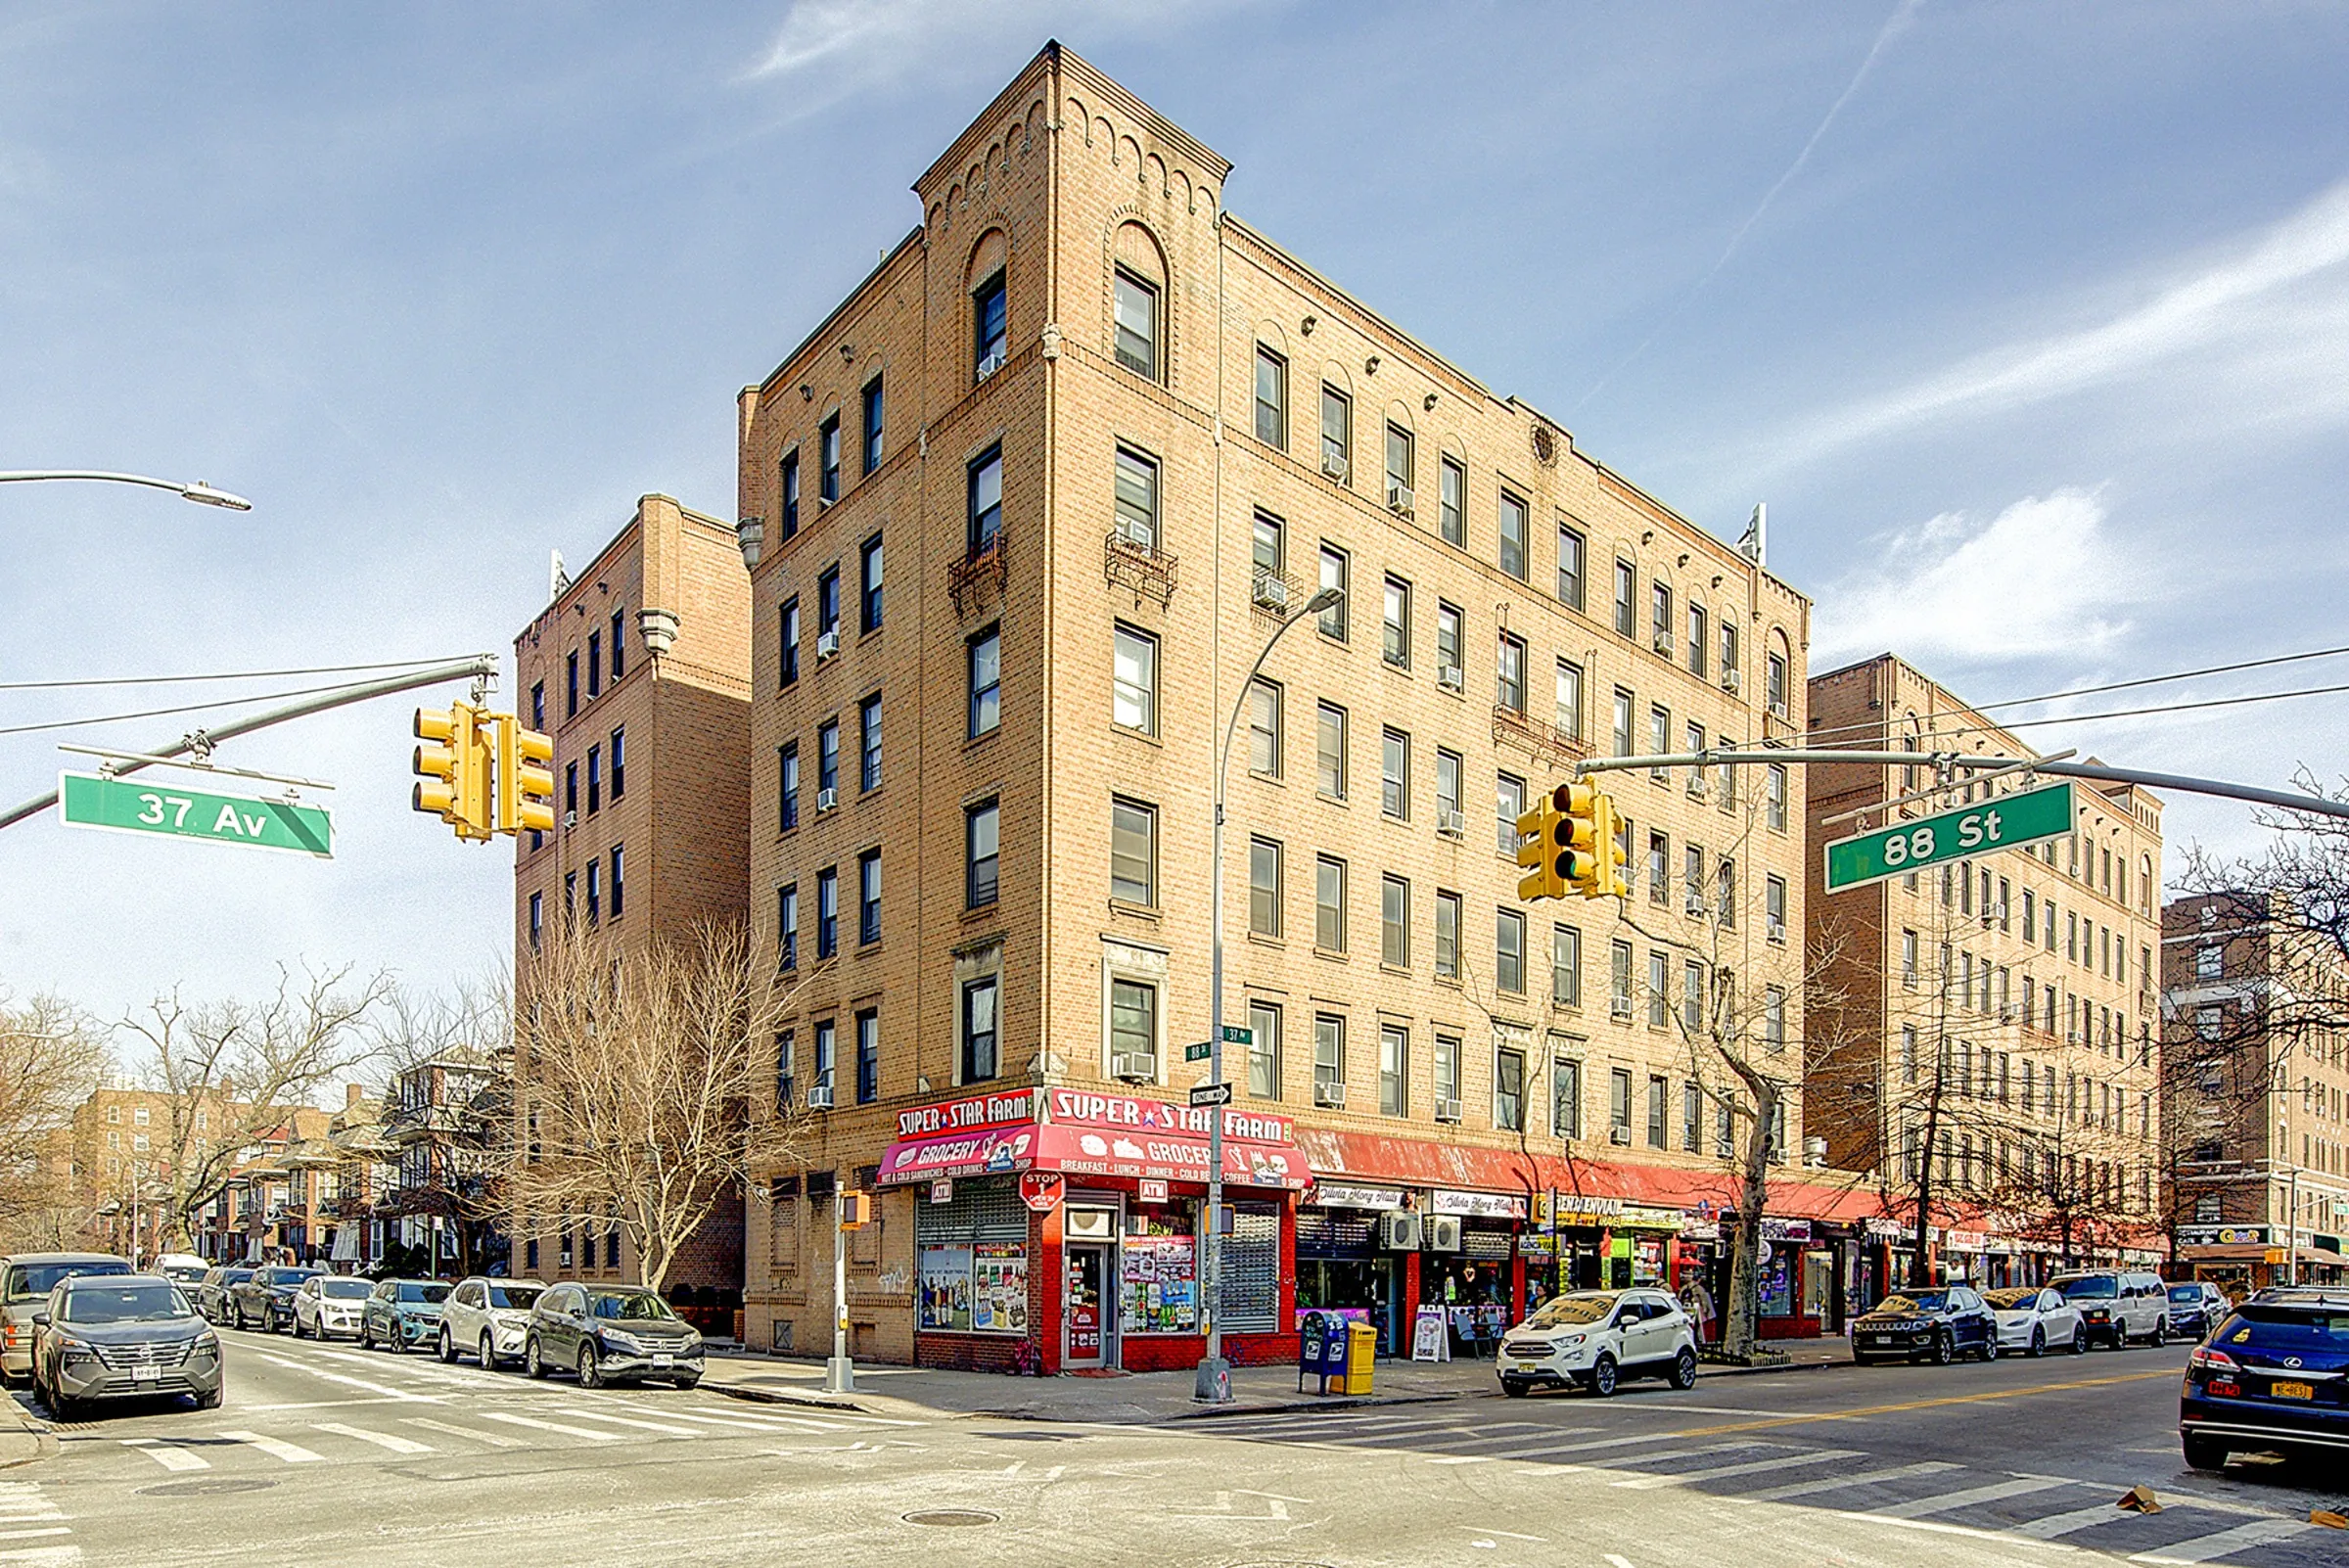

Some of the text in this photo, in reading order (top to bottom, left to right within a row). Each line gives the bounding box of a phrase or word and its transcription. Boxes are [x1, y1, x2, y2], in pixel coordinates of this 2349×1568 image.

[137, 793, 266, 838] 37 Av
[1883, 809, 2002, 866] 88 St
[1228, 1028, 1238, 1041] 37
[1191, 1045, 1200, 1059] 88
[1195, 1089, 1226, 1102] ONE WAY
[898, 1108, 940, 1135] SUPER
[950, 1100, 984, 1128] STAR
[1056, 1092, 1140, 1125] SUPER
[917, 1139, 980, 1165] GROCERY
[1147, 1141, 1212, 1166] GROCER
[882, 1174, 892, 1183] HOT
[897, 1171, 910, 1181] COLD
[910, 1168, 944, 1180] SANDWICHES
[946, 1165, 962, 1176] COLD
[962, 1163, 984, 1175] DRINKS
[1015, 1158, 1033, 1170] SHOP
[1026, 1174, 1059, 1183] STOP
[1060, 1159, 1107, 1174] BREAKFAST
[1114, 1163, 1139, 1176] LUNCH
[1146, 1166, 1174, 1178] DINNER
[1178, 1168, 1198, 1180] COLD
[1223, 1172, 1251, 1184] COFFEE
[1287, 1176, 1306, 1187] SHOP
[935, 1184, 950, 1198] ATM
[1143, 1183, 1165, 1197] ATM
